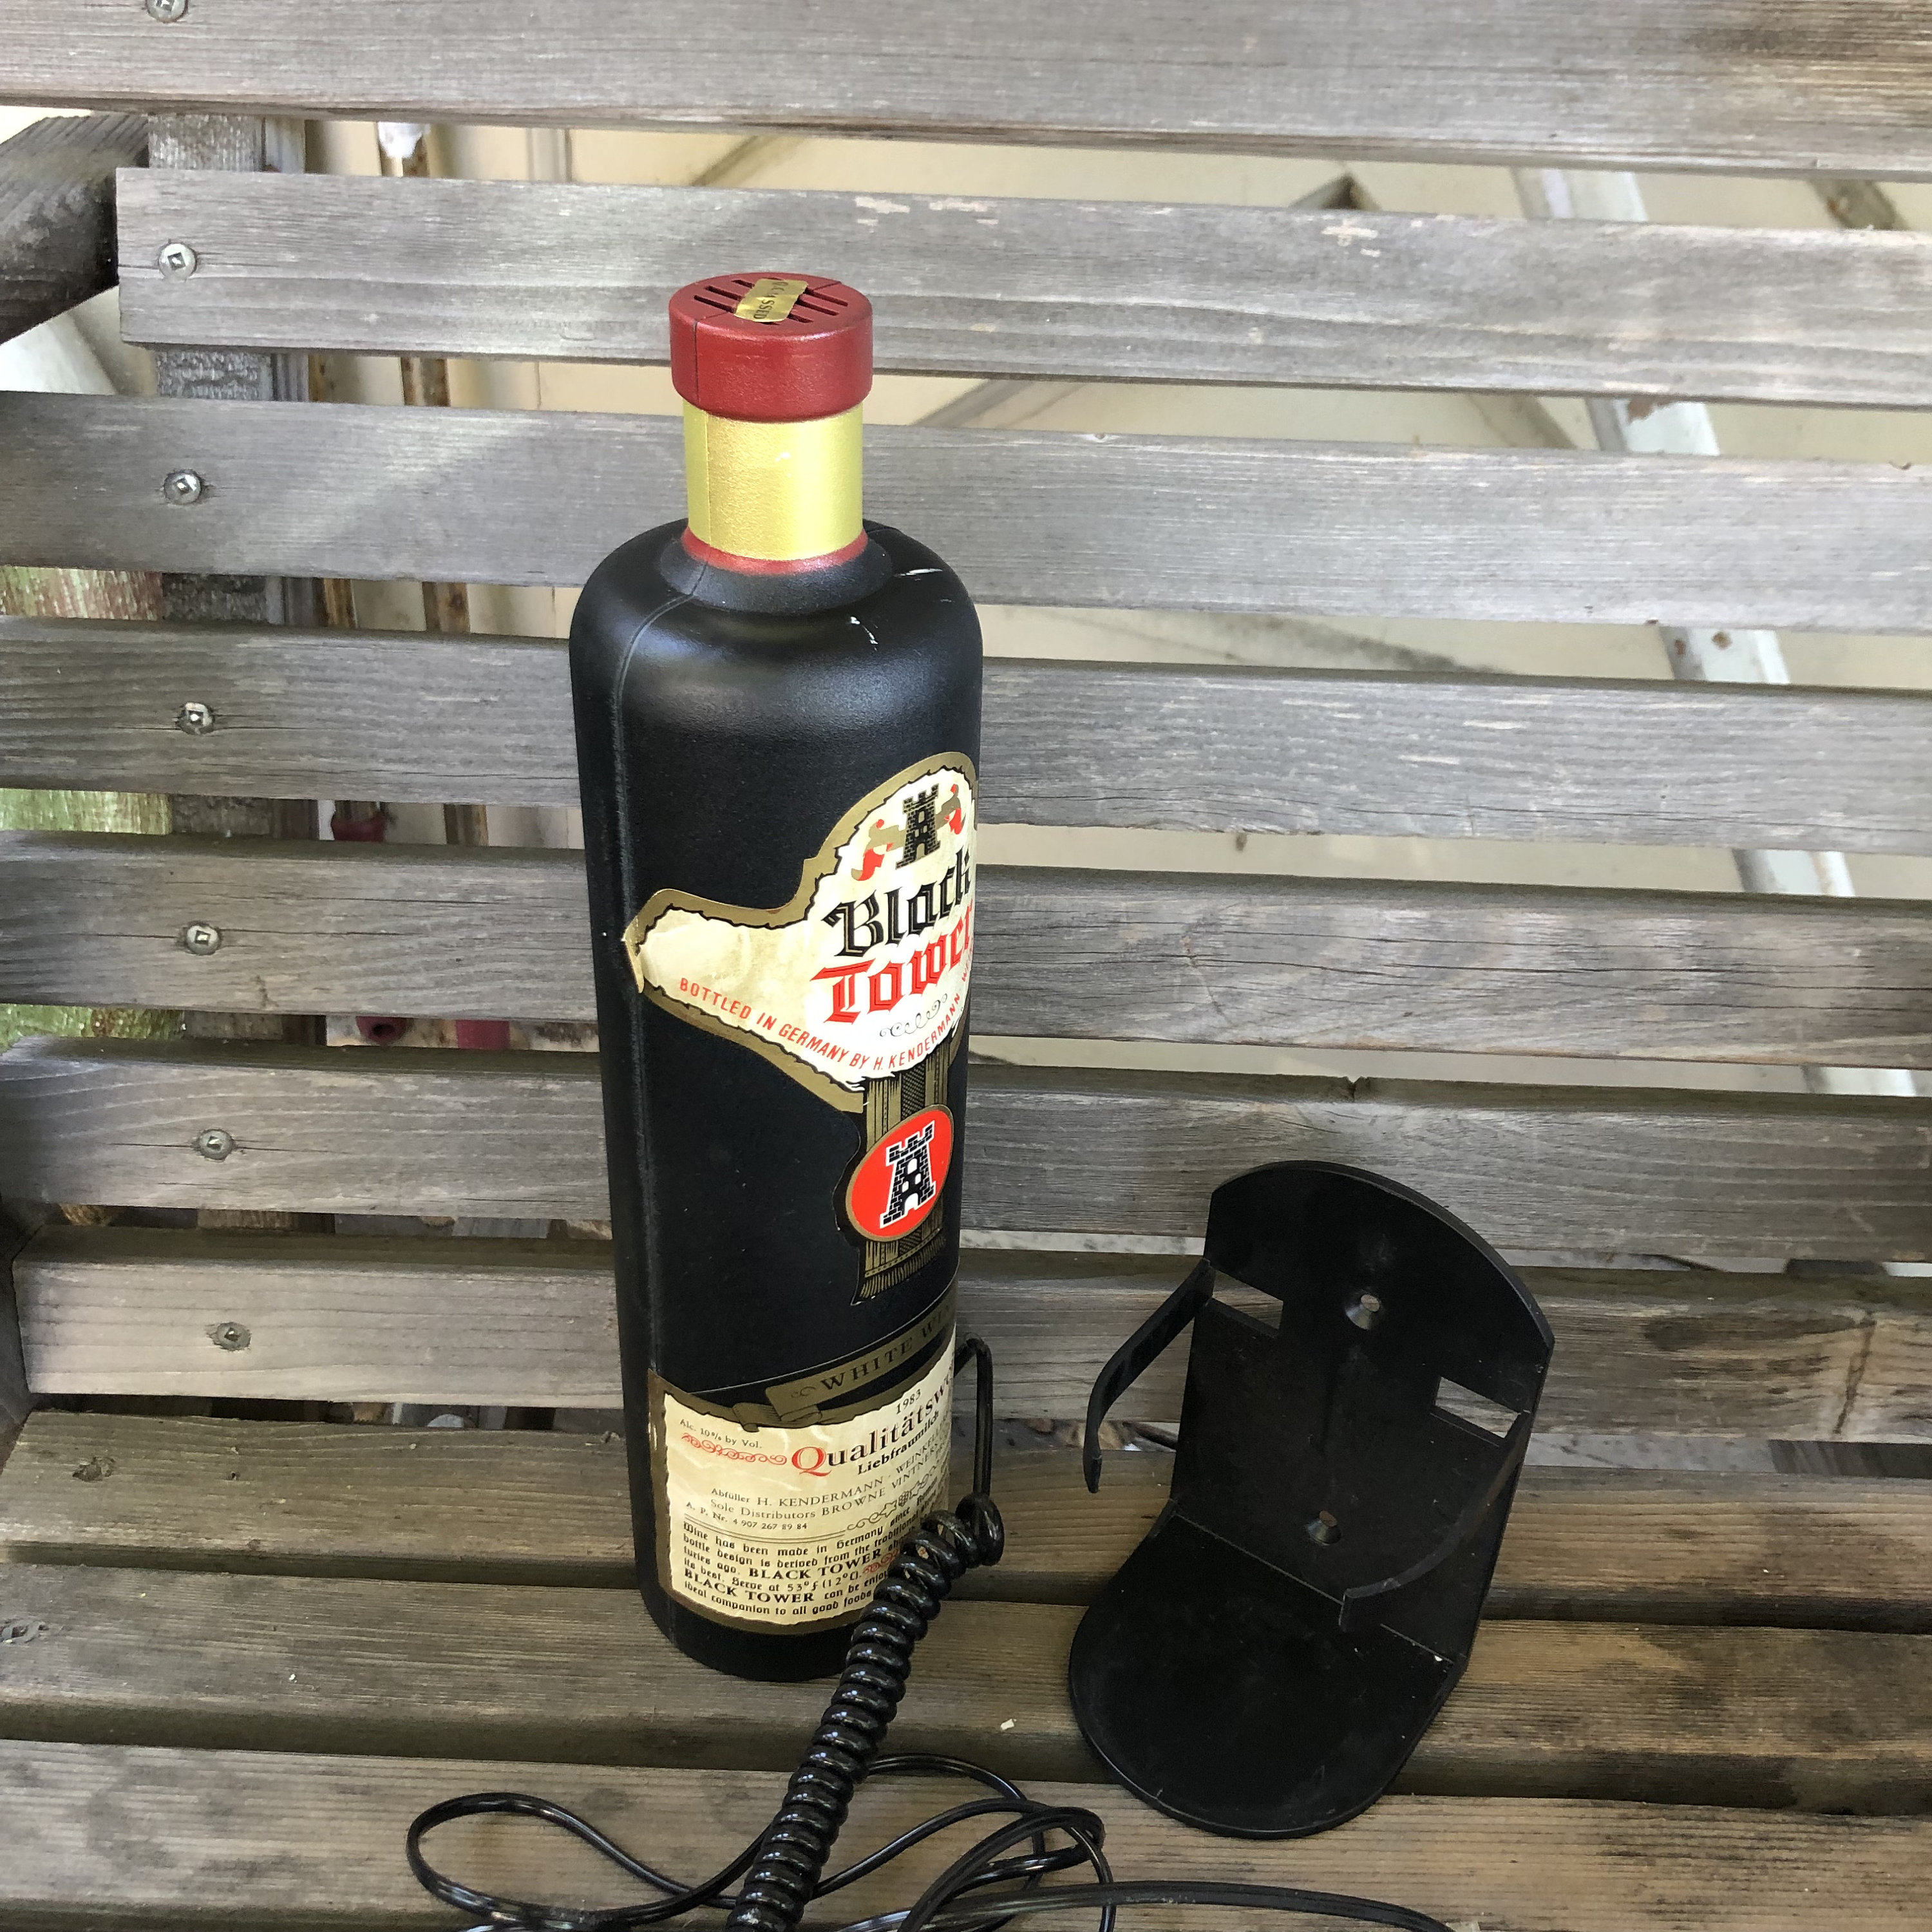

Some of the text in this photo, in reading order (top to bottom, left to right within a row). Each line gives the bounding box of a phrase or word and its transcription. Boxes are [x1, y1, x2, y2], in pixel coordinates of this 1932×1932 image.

[821, 846, 971, 957] Black
[810, 898, 973, 1025] Tower
[679, 978, 960, 1070] BOTTLED IN GERMANY BY H. KENDERMANN
[820, 1337, 912, 1390] WHITE
[896, 1388, 922, 1415] 1983
[679, 1418, 696, 1432] Alc.
[725, 1435, 737, 1446] by
[741, 1439, 762, 1449] Vol.
[857, 1410, 940, 1475] Liebfraumilch
[710, 1499, 734, 1513] Sole
[741, 1506, 816, 1520] Distributors
[822, 1486, 886, 1516] BROWNE
[711, 1488, 750, 1503] Abfüller
[757, 1496, 772, 1506] H.
[779, 1475, 884, 1507] KENDERMANN
[686, 1501, 696, 1511] A.
[700, 1507, 708, 1516] P.
[712, 1511, 728, 1522] Nr.
[741, 1519, 758, 1528] 907
[761, 1522, 778, 1530] 267
[683, 1521, 709, 1540] Wine
[715, 1535, 736, 1549] has
[743, 1544, 769, 1555] been
[777, 1546, 809, 1557] made
[816, 1544, 828, 1555] in
[837, 1526, 884, 1549] Germany
[683, 1533, 711, 1553] bottle
[717, 1549, 753, 1566] design
[761, 1558, 771, 1567] is
[777, 1558, 818, 1569] derived
[824, 1551, 850, 1566] from
[855, 1544, 871, 1556] the
[683, 1546, 712, 1565] turies
[717, 1562, 741, 1575] ago.
[749, 1567, 811, 1580] BLACK
[817, 1548, 882, 1577] TOWER
[683, 1557, 696, 1570] its
[701, 1565, 725, 1582] best.
[731, 1577, 763, 1590] Serve
[769, 1583, 780, 1592] at
[684, 1567, 739, 1598] BLACK
[745, 1589, 815, 1604] TOWER
[824, 1589, 844, 1600] can
[848, 1582, 860, 1594] be
[684, 1580, 872, 1616] ideal companion to all good foods
